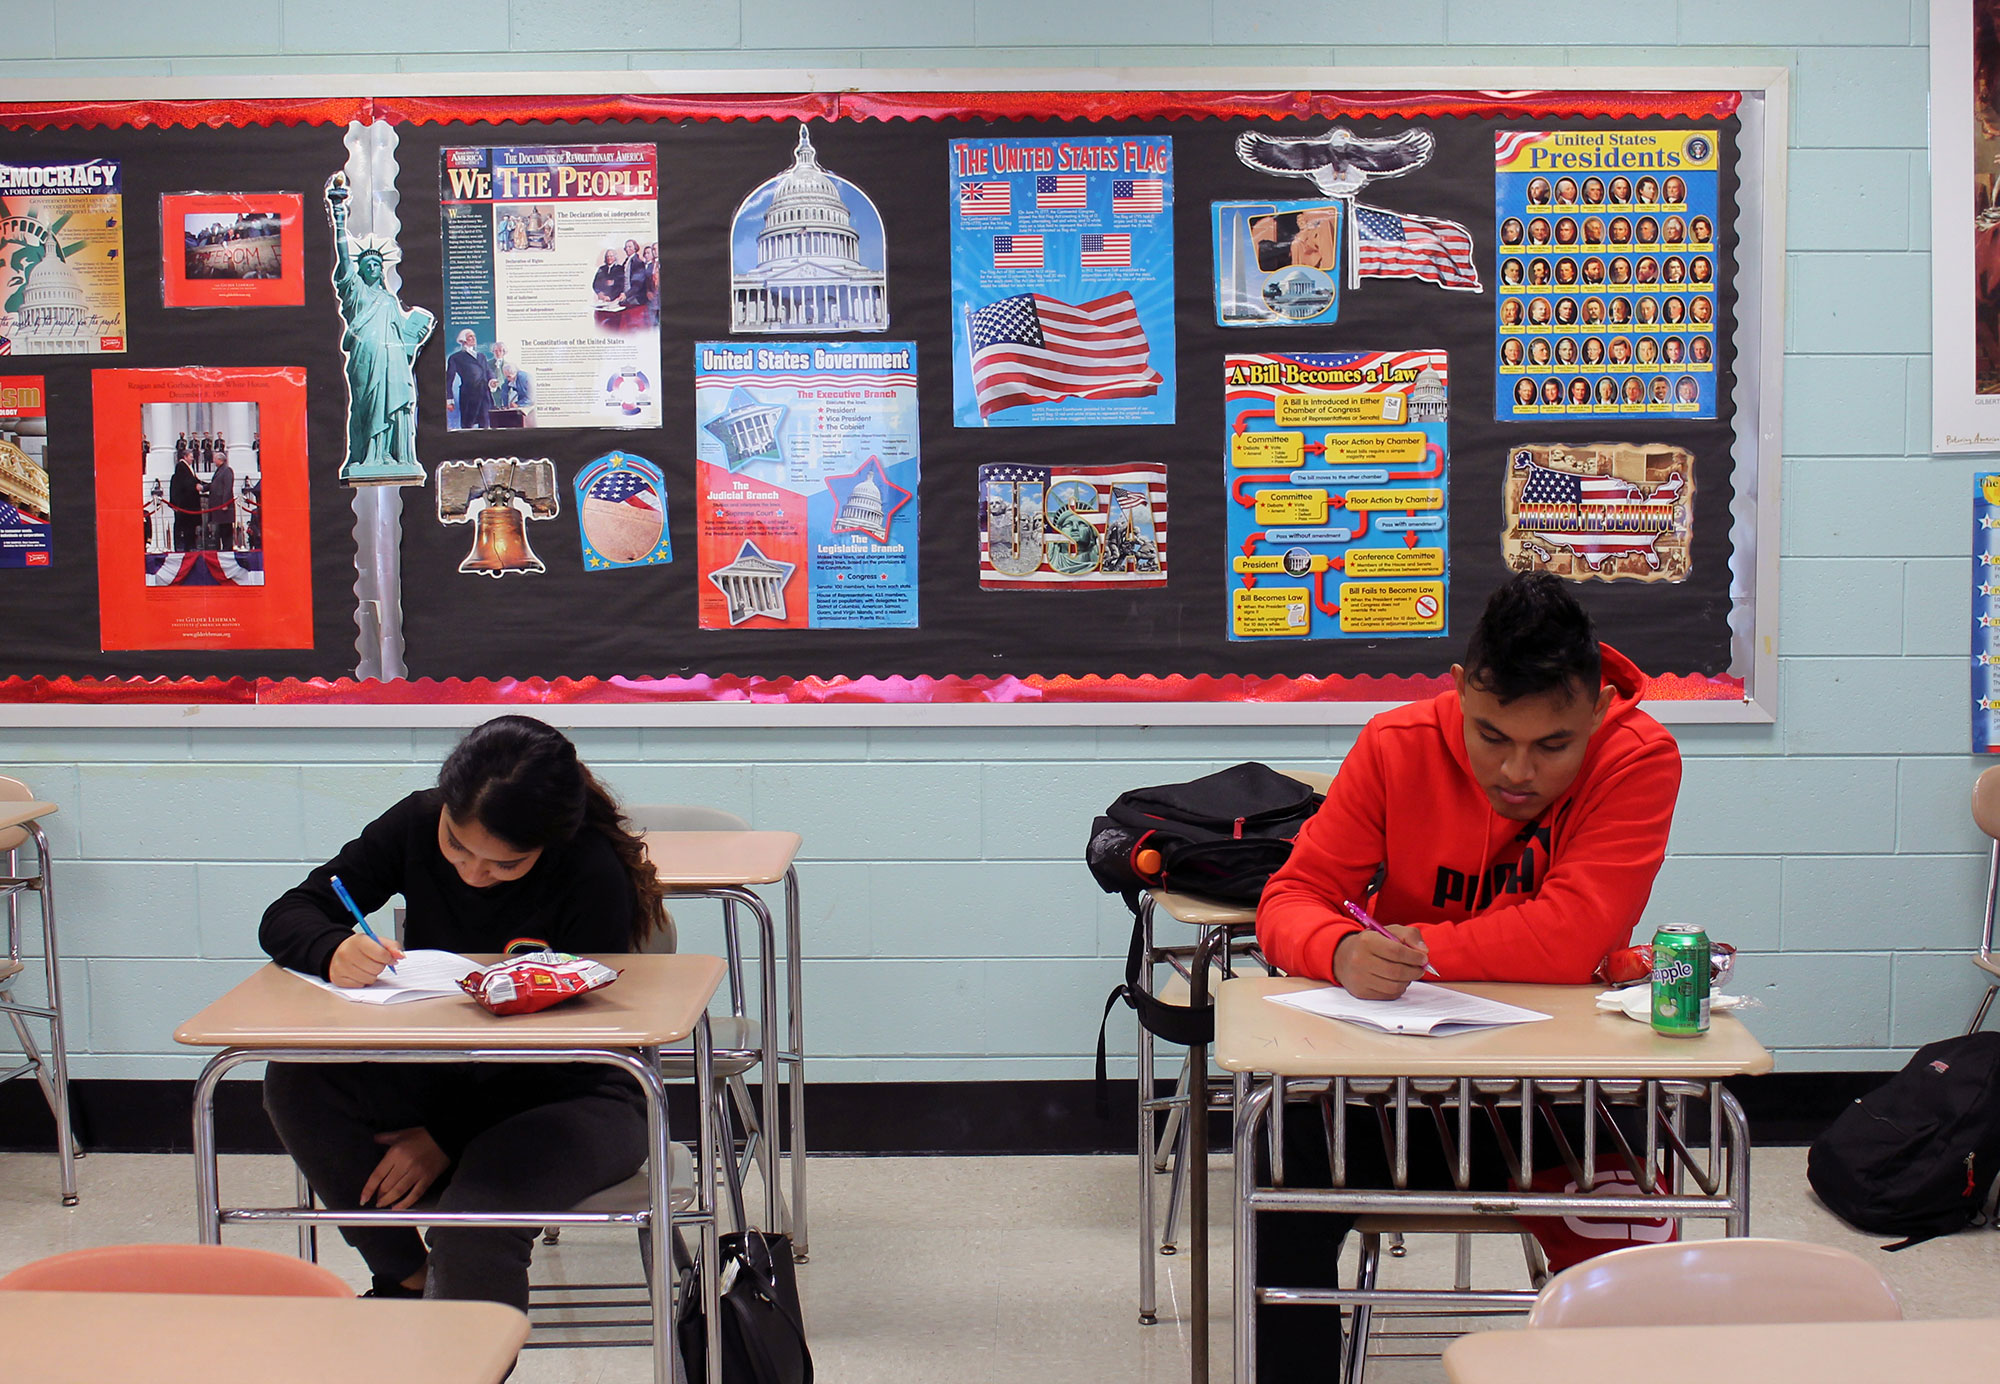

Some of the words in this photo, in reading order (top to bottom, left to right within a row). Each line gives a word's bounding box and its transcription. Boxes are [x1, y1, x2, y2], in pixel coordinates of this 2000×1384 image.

[1554, 134, 1604, 146] United
[1609, 134, 1656, 145] States
[504, 152, 514, 164] THE
[516, 152, 556, 164] DOCUMENTS
[565, 151, 615, 164] REVOLUTIONARY
[617, 150, 644, 162] AMERICA
[955, 144, 988, 177] THE
[992, 143, 1054, 174] UNITED
[1058, 142, 1118, 172] STATES
[1123, 142, 1168, 174] FLAG
[1530, 147, 1681, 168] Presidents
[0, 166, 117, 188] EMOCRACY
[448, 168, 492, 198] WE
[497, 167, 552, 198] THE
[558, 166, 654, 198] PEOPLE
[703, 350, 753, 370] United
[758, 350, 810, 370] States
[814, 349, 910, 370] Government
[1231, 365, 1246, 384] A
[1250, 363, 1280, 384] Bill
[1286, 364, 1362, 384] Becomes
[1366, 369, 1377, 382] a
[1382, 363, 1418, 382] Law
[798, 390, 814, 398] The
[817, 390, 861, 398] Executive
[864, 390, 897, 398] Branch
[1376, 438, 1384, 446] by
[733, 482, 750, 490] The
[707, 491, 744, 500] Judicial
[746, 491, 779, 500] Branch
[1394, 496, 1404, 504] by
[1518, 503, 1578, 531] AMERICA
[1578, 504, 1604, 532] THE
[1605, 504, 1675, 532] BEAUTIFUL
[988, 480, 1162, 576] USA
[851, 535, 868, 544] The
[818, 544, 868, 554] Legislative
[871, 544, 904, 552] Branch
[1652, 960, 1692, 985] napple
